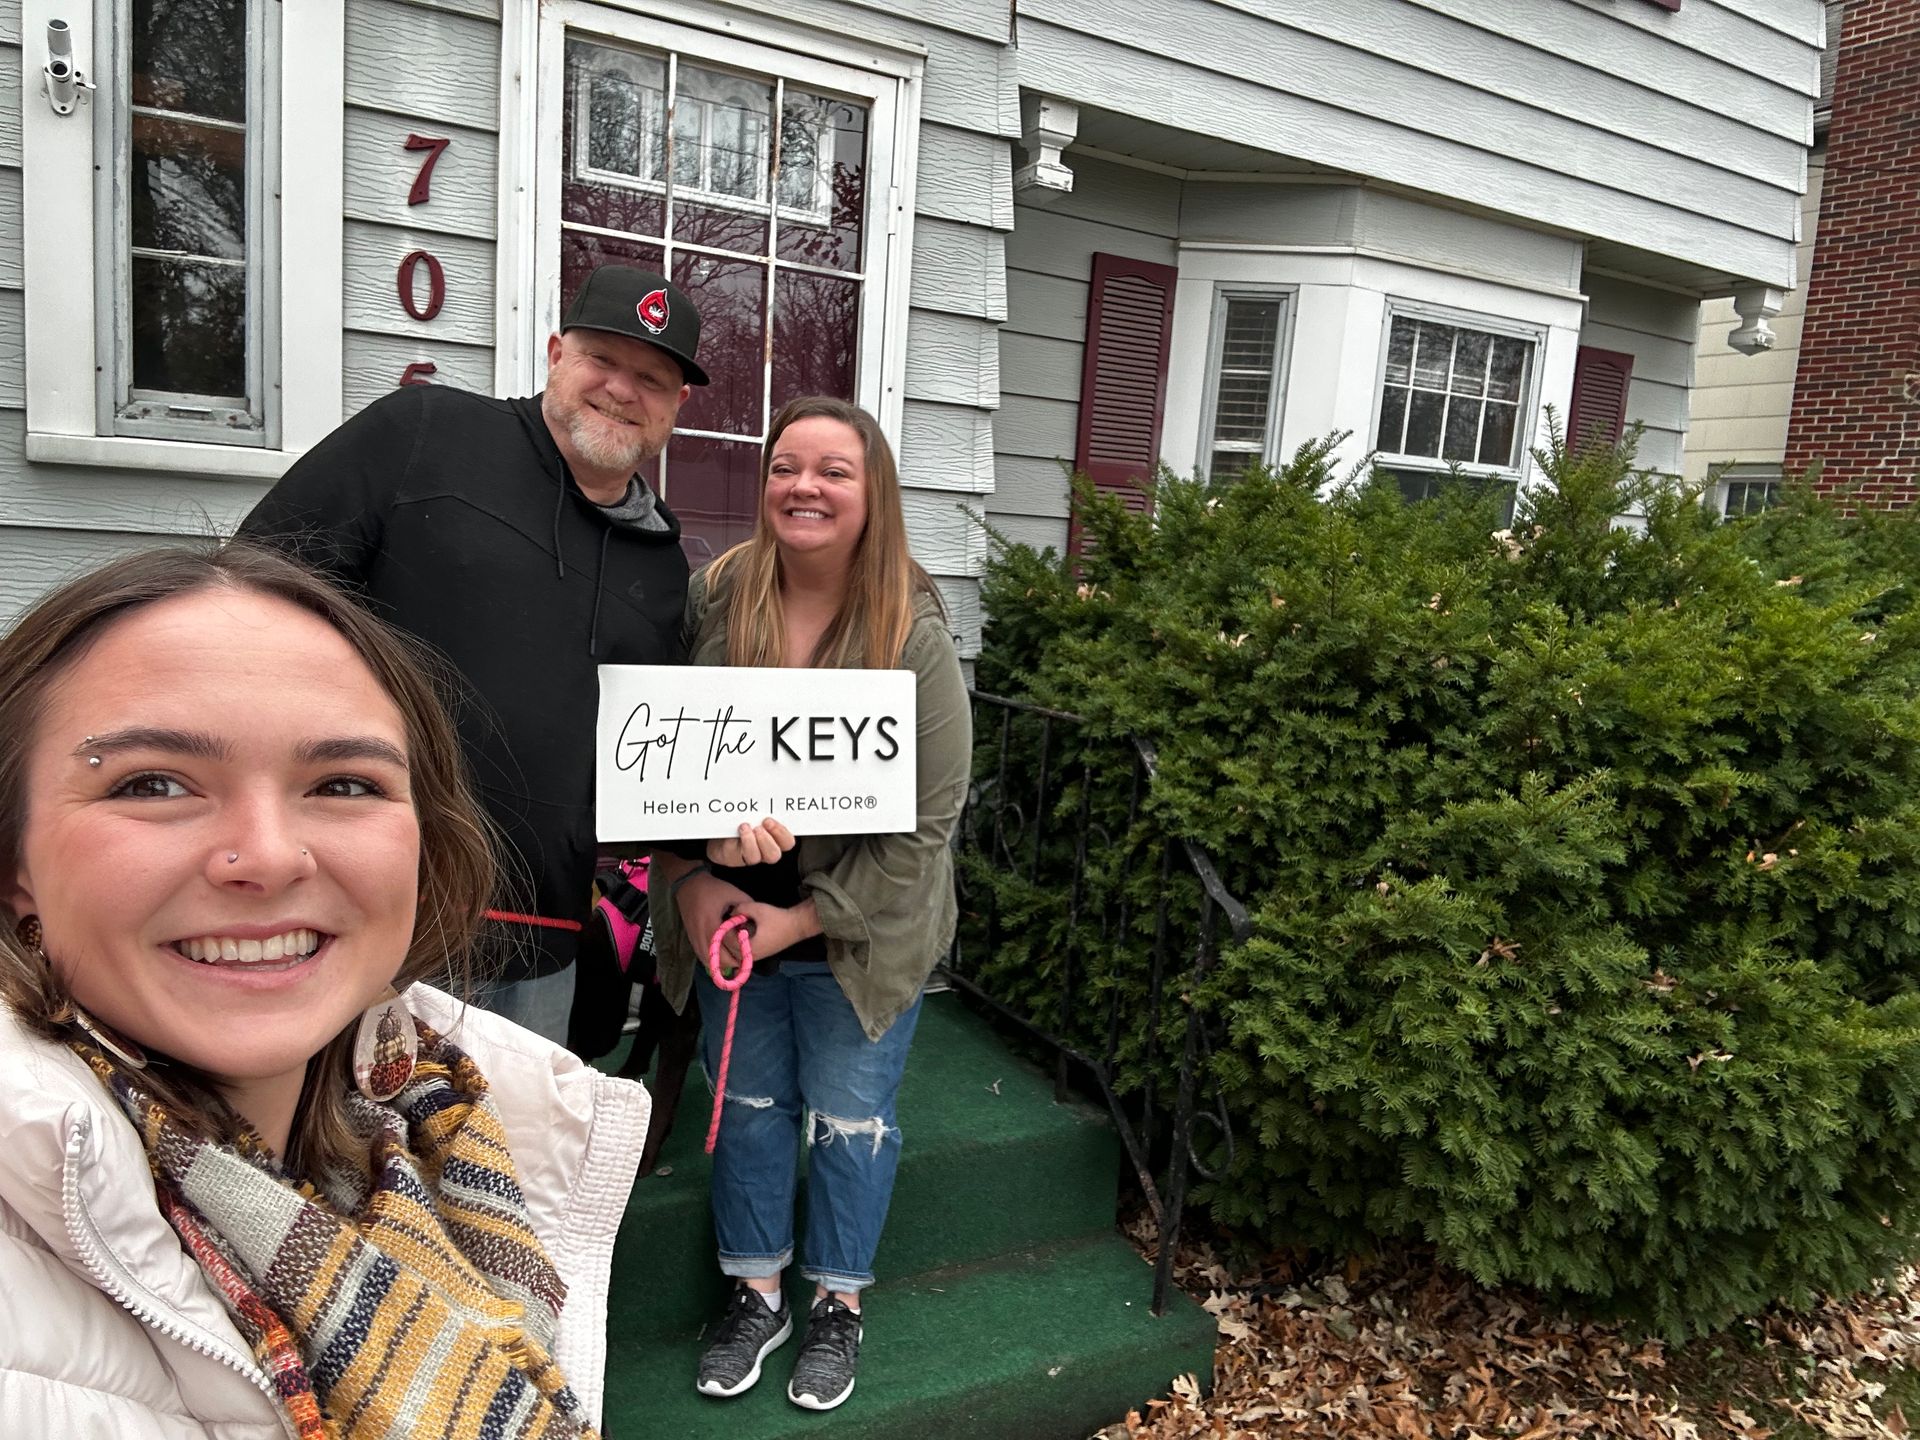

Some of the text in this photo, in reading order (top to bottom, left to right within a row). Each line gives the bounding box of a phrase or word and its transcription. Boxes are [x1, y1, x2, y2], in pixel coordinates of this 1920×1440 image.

[615, 702, 900, 782] Got the KEYS
[643, 799, 700, 815] Helen
[708, 798, 759, 813] Cook
[785, 795, 878, 811] REALTOR®
